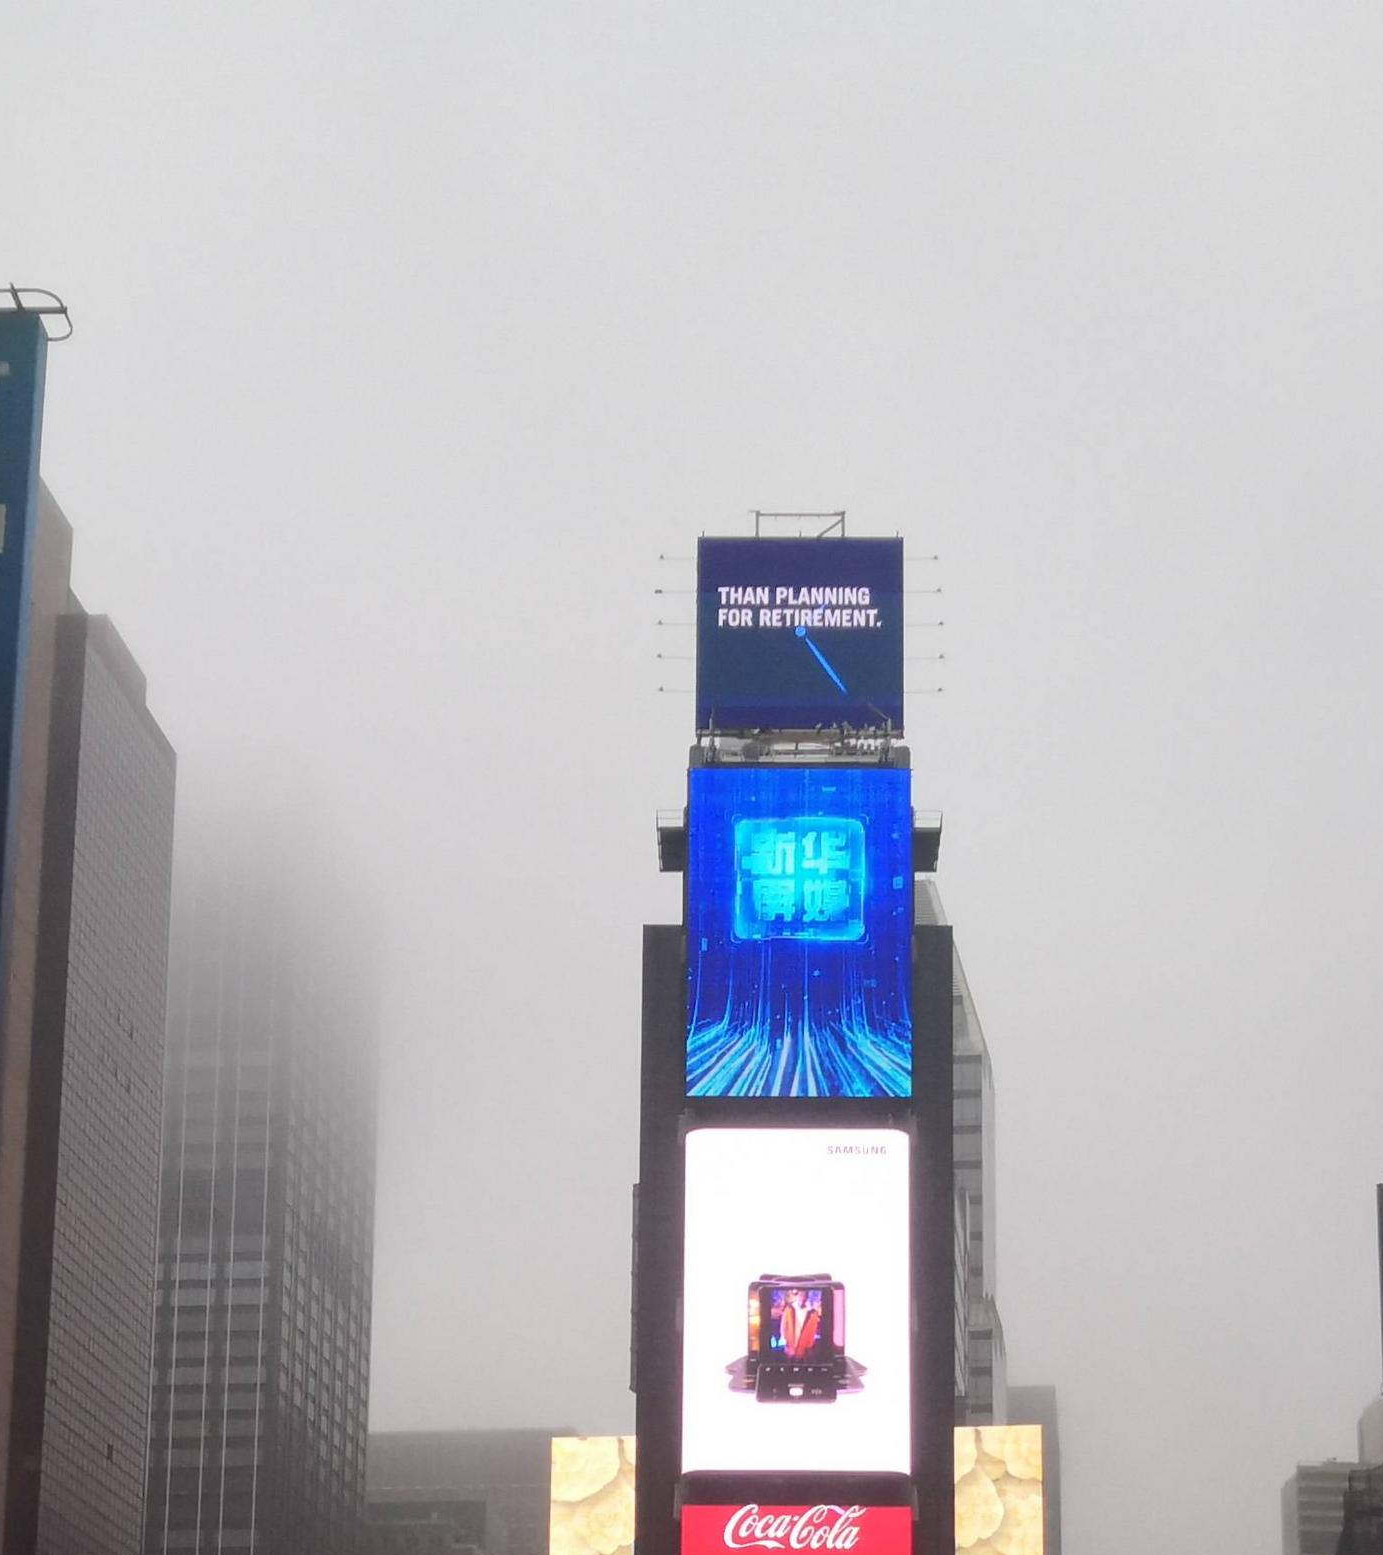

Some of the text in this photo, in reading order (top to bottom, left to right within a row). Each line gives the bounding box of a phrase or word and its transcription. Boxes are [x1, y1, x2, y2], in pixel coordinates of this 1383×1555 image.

[718, 587, 870, 606] THAN PLANNING
[718, 609, 883, 628] FOR RETIREMENT.
[827, 1145, 888, 1155] SAMSUNG
[724, 1504, 867, 1550] Coca-Cola
